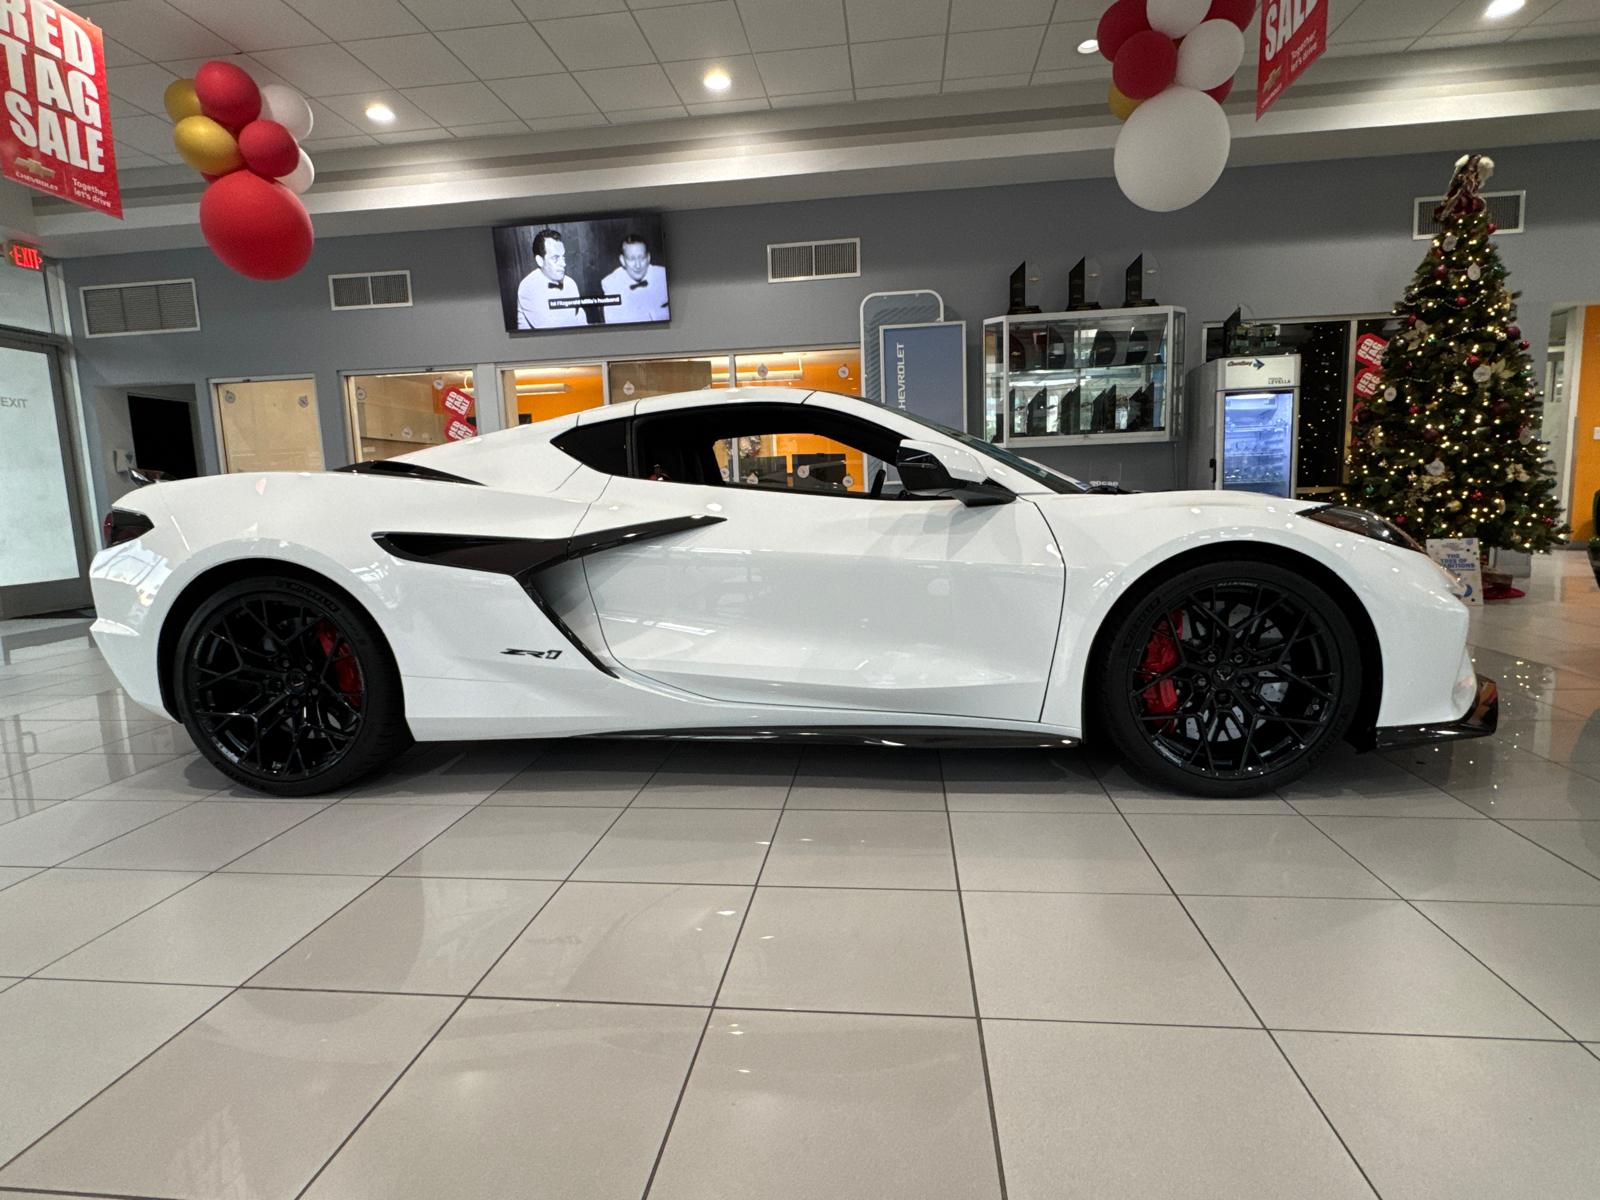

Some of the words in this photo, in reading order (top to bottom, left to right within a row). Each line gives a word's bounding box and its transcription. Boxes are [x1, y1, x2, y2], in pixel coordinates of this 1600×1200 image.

[0, 0, 96, 76] RED
[0, 37, 102, 128] TAG
[4, 90, 105, 173] SALE
[15, 171, 59, 191] CHEVROLET
[72, 177, 108, 198] Together
[73, 187, 92, 200] let's
[92, 195, 112, 208] drive
[13, 244, 39, 270] EXIT
[1357, 338, 1374, 359] RED
[1363, 341, 1383, 361] TAG
[896, 342, 906, 411] HEVROLET
[1356, 372, 1373, 391] RED
[0, 397, 27, 408] EXIT
[445, 391, 458, 410] RED
[448, 421, 460, 439] RED
